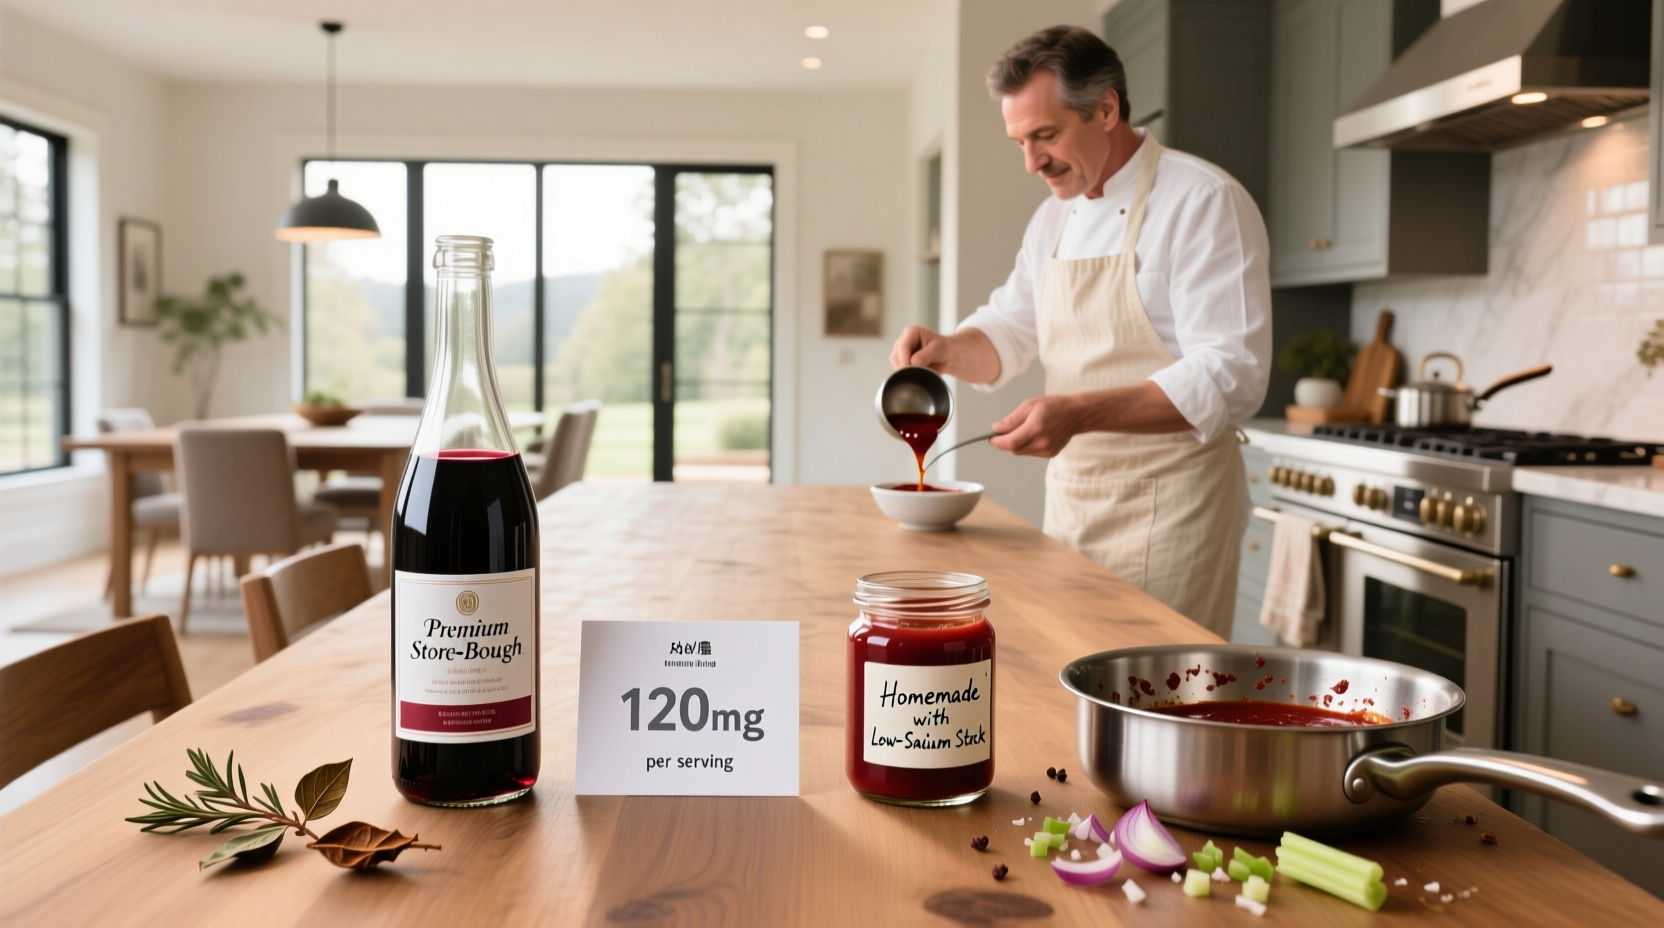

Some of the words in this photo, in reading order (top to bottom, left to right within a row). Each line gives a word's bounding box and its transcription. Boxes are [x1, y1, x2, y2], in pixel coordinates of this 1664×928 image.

[423, 618, 509, 639] Premium
[410, 635, 522, 664] Store-Bough
[880, 677, 980, 708] Homemade
[620, 686, 765, 742] 120mg
[913, 707, 950, 726] with
[646, 756, 672, 772] per
[677, 754, 734, 772] serving
